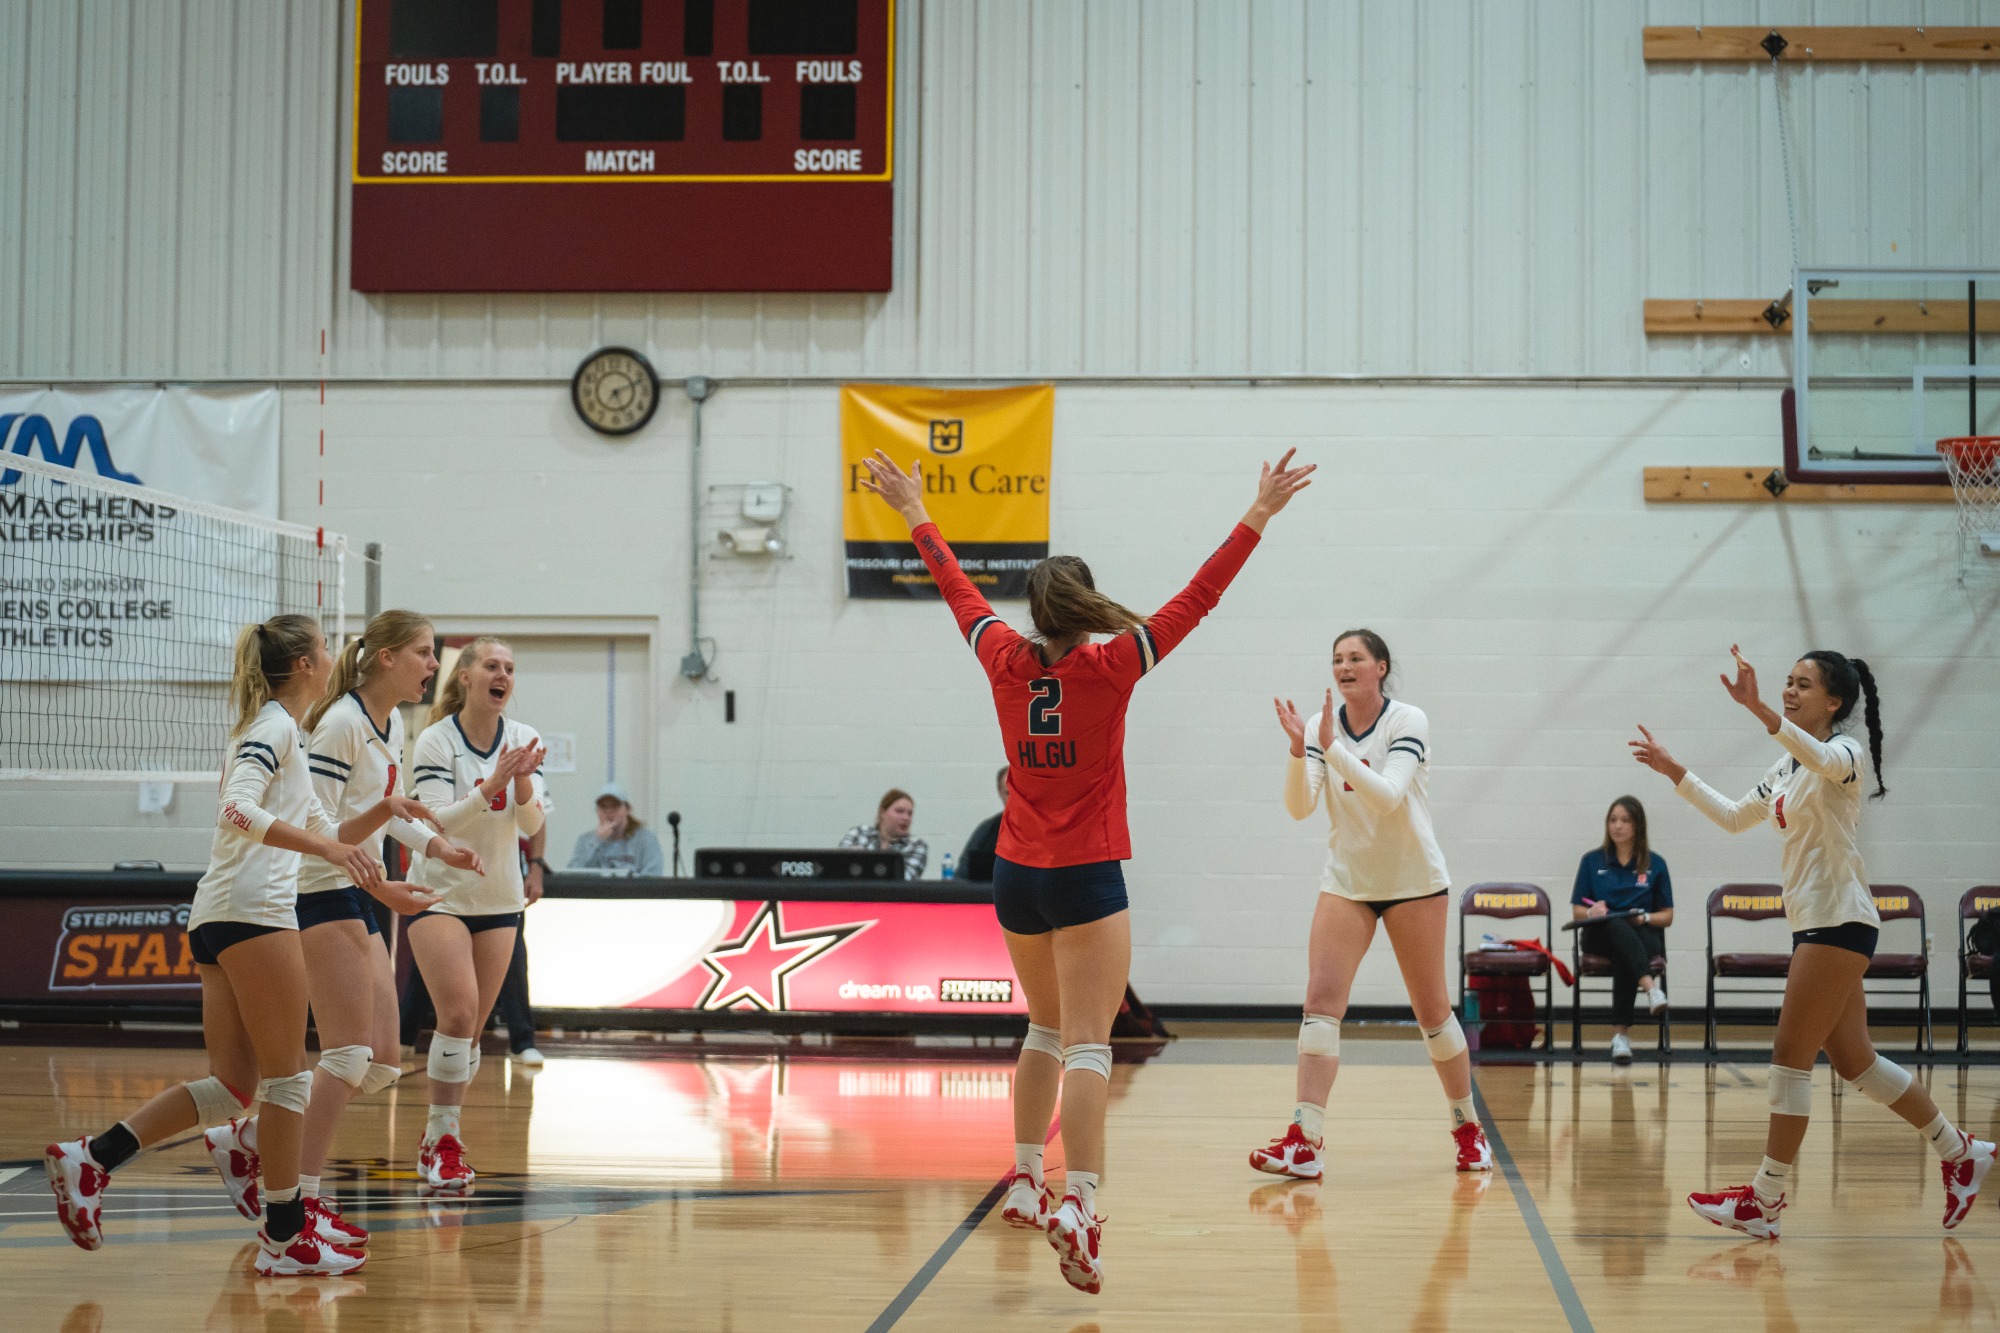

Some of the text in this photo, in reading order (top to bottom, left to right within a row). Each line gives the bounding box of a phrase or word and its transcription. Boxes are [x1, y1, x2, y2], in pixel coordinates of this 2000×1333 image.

[385, 63, 450, 86] FOULS
[475, 63, 528, 85] T.O.L.
[556, 61, 693, 84] PLAYER FOUL
[717, 61, 771, 83] T.O.L.
[796, 60, 863, 83] FOULS
[382, 151, 448, 174] SCORE
[585, 150, 655, 172] MATCH
[794, 149, 862, 172] SCORE
[970, 464, 1046, 494] Care
[846, 558, 900, 570] MISSOURI
[35, 578, 57, 592] TO
[61, 577, 145, 592] SPONSOR
[58, 600, 173, 620] COLLEGE
[1028, 677, 1062, 735] 2
[1018, 740, 1077, 768] HLGU
[781, 861, 814, 876] POSS
[1474, 893, 1537, 908] STEPHENS
[69, 911, 171, 927] STEPHENS
[838, 980, 902, 999] dream
[941, 980, 1011, 993] STEPHENS
[941, 993, 1010, 1001] COLLEGE
